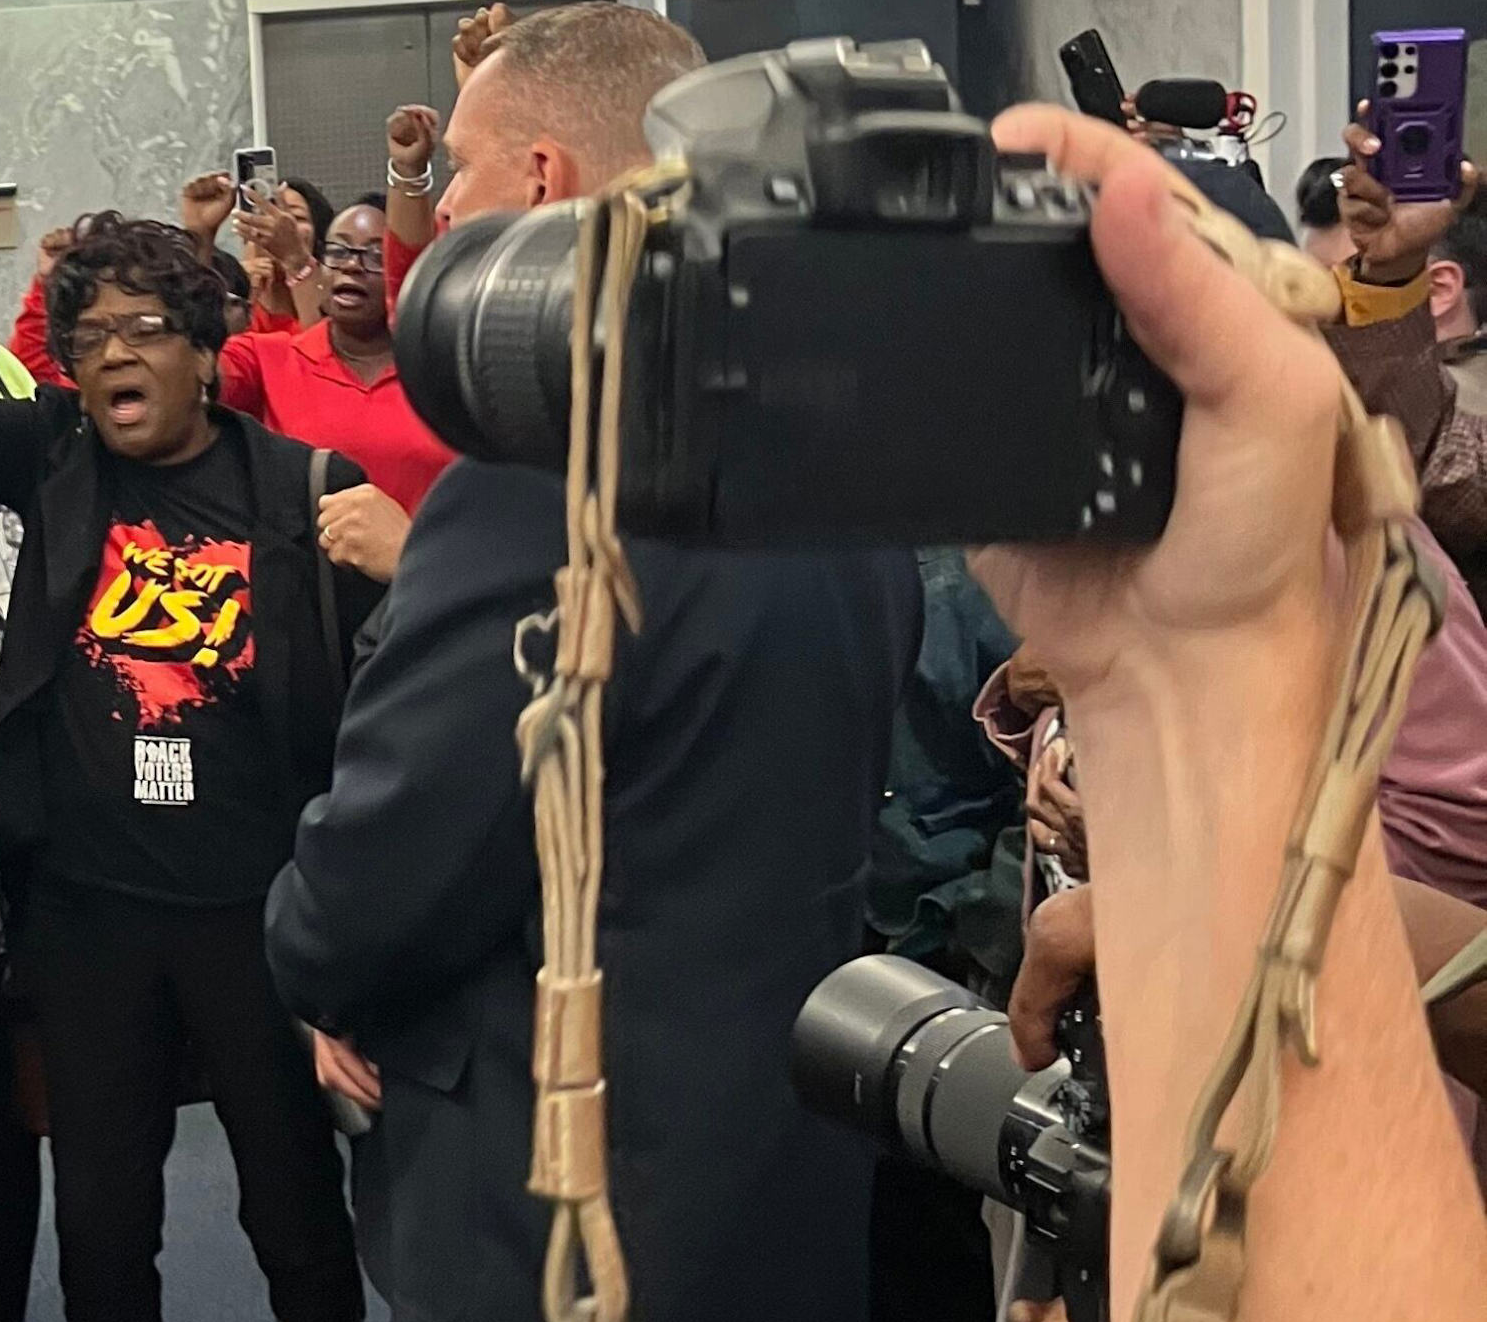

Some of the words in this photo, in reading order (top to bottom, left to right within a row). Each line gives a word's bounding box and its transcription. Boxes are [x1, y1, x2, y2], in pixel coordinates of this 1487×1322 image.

[122, 541, 174, 576] WE
[90, 570, 242, 668] US!
[135, 760, 193, 782] VOTERS
[134, 779, 195, 801] MATTER
